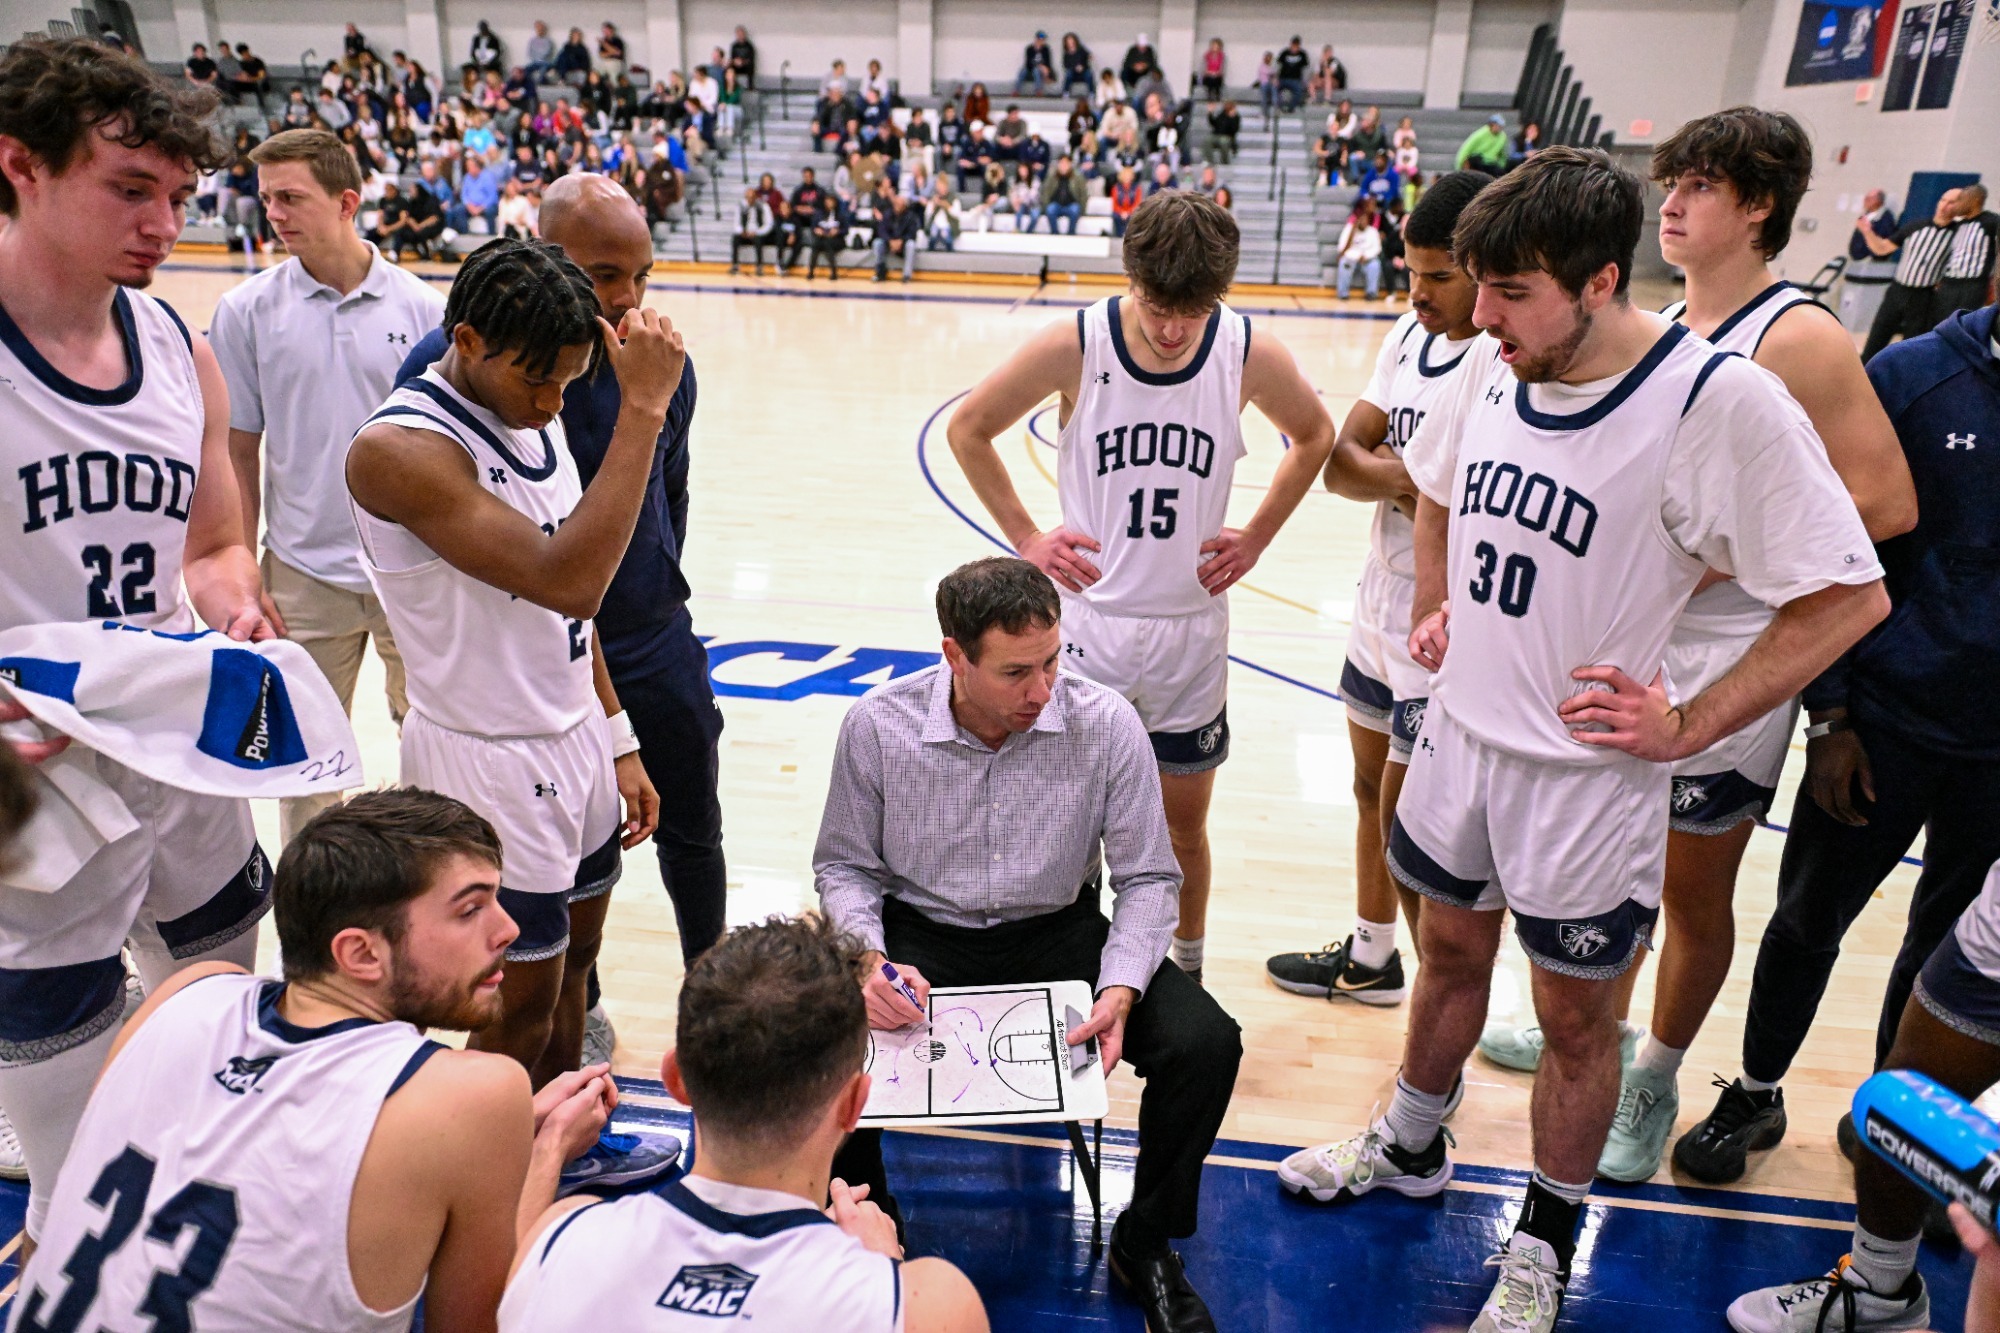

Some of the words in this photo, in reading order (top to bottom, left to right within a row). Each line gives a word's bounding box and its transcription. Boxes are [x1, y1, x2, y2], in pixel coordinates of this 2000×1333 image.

[1096, 422, 1215, 479] HOOD
[18, 451, 196, 534] HOOD
[1127, 488, 1179, 539] 15
[1459, 461, 1599, 558] HOOD
[81, 541, 157, 618] 22
[1469, 539, 1538, 618] 30
[4, 1140, 243, 1333] 33
[661, 1281, 747, 1315] MAC
